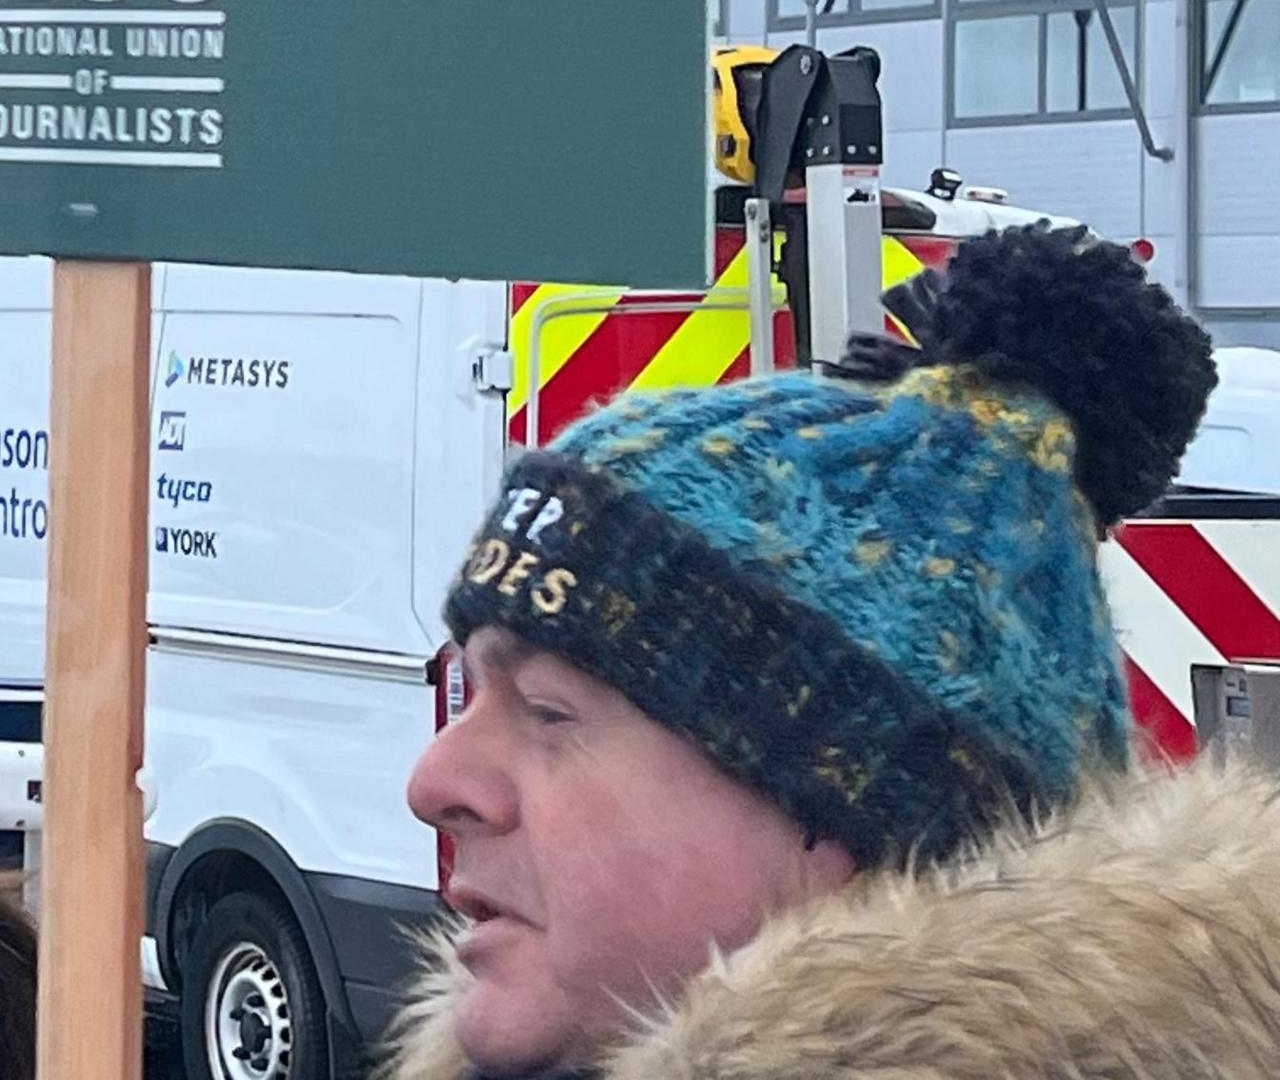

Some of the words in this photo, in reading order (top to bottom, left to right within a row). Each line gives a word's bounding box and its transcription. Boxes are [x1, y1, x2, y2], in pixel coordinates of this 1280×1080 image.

[125, 26, 224, 60] UNION
[74, 67, 110, 95] OF
[187, 357, 289, 389] METASYS
[156, 473, 213, 508] tyco
[170, 528, 217, 558] YORK
